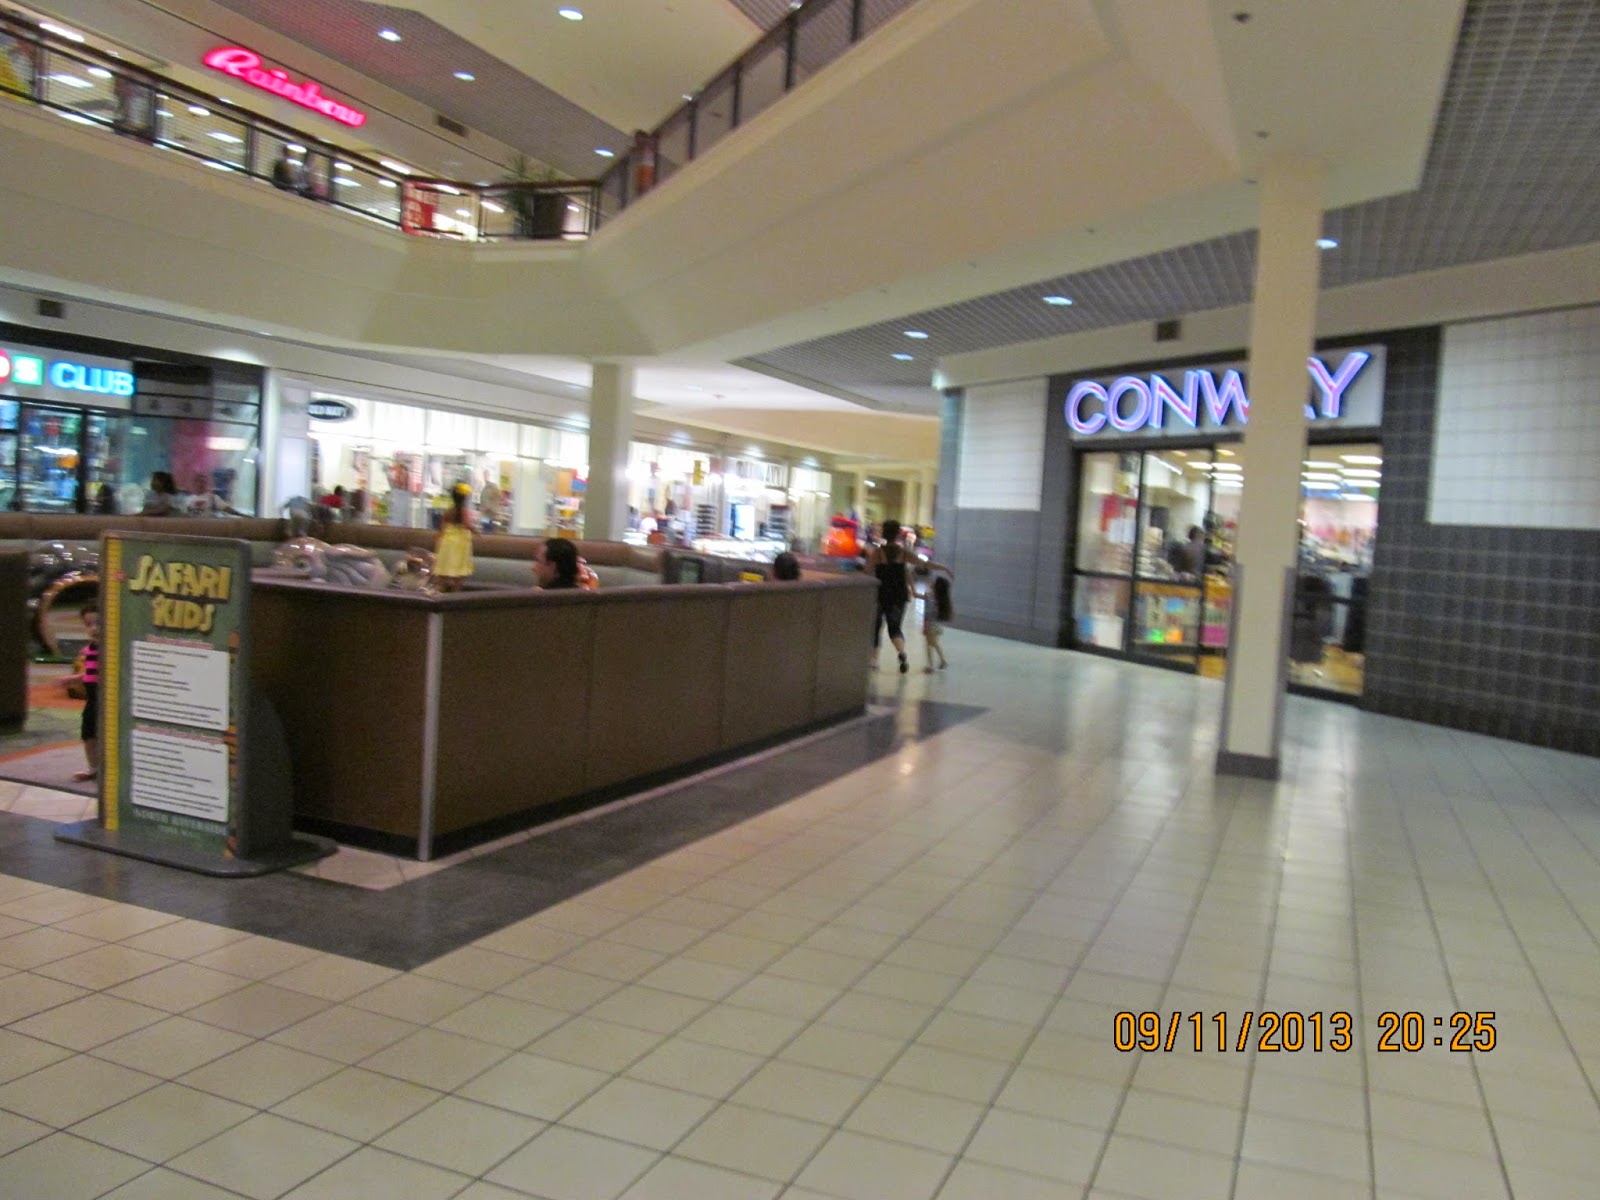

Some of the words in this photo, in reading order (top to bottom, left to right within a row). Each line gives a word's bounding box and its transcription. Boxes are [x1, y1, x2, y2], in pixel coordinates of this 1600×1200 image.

[203, 46, 367, 129] Rainbow
[50, 360, 136, 397] CLUB
[1065, 352, 1370, 435] CONWY
[128, 555, 231, 600] SAFARI
[152, 595, 215, 632] KIDS
